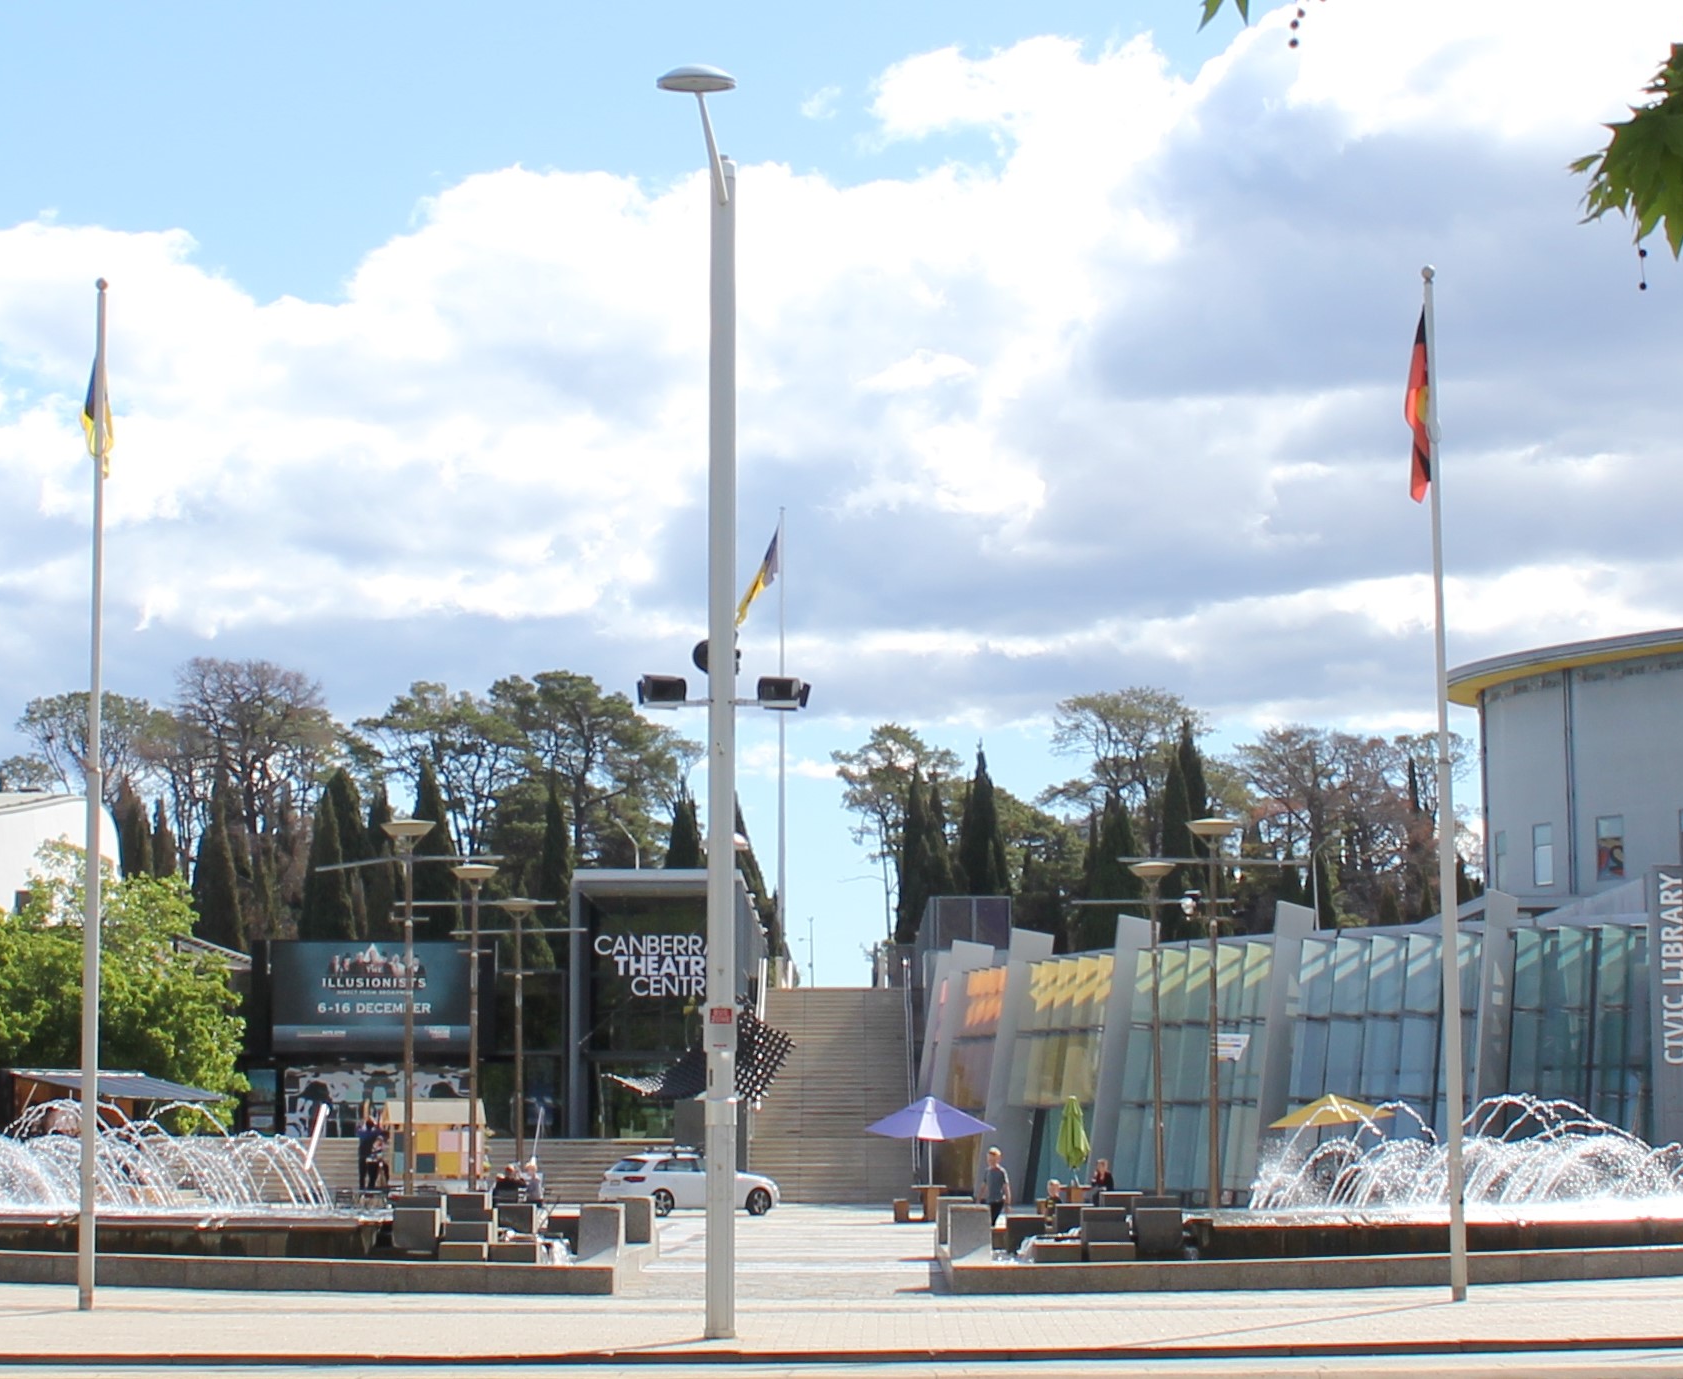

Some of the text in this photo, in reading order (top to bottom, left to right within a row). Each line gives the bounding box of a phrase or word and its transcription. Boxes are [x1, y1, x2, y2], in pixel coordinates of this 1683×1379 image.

[366, 964, 383, 974] THE
[614, 956, 707, 976] THEATR
[631, 976, 706, 996] CENTR
[317, 1002, 431, 1014] 6-16 DECEMER
